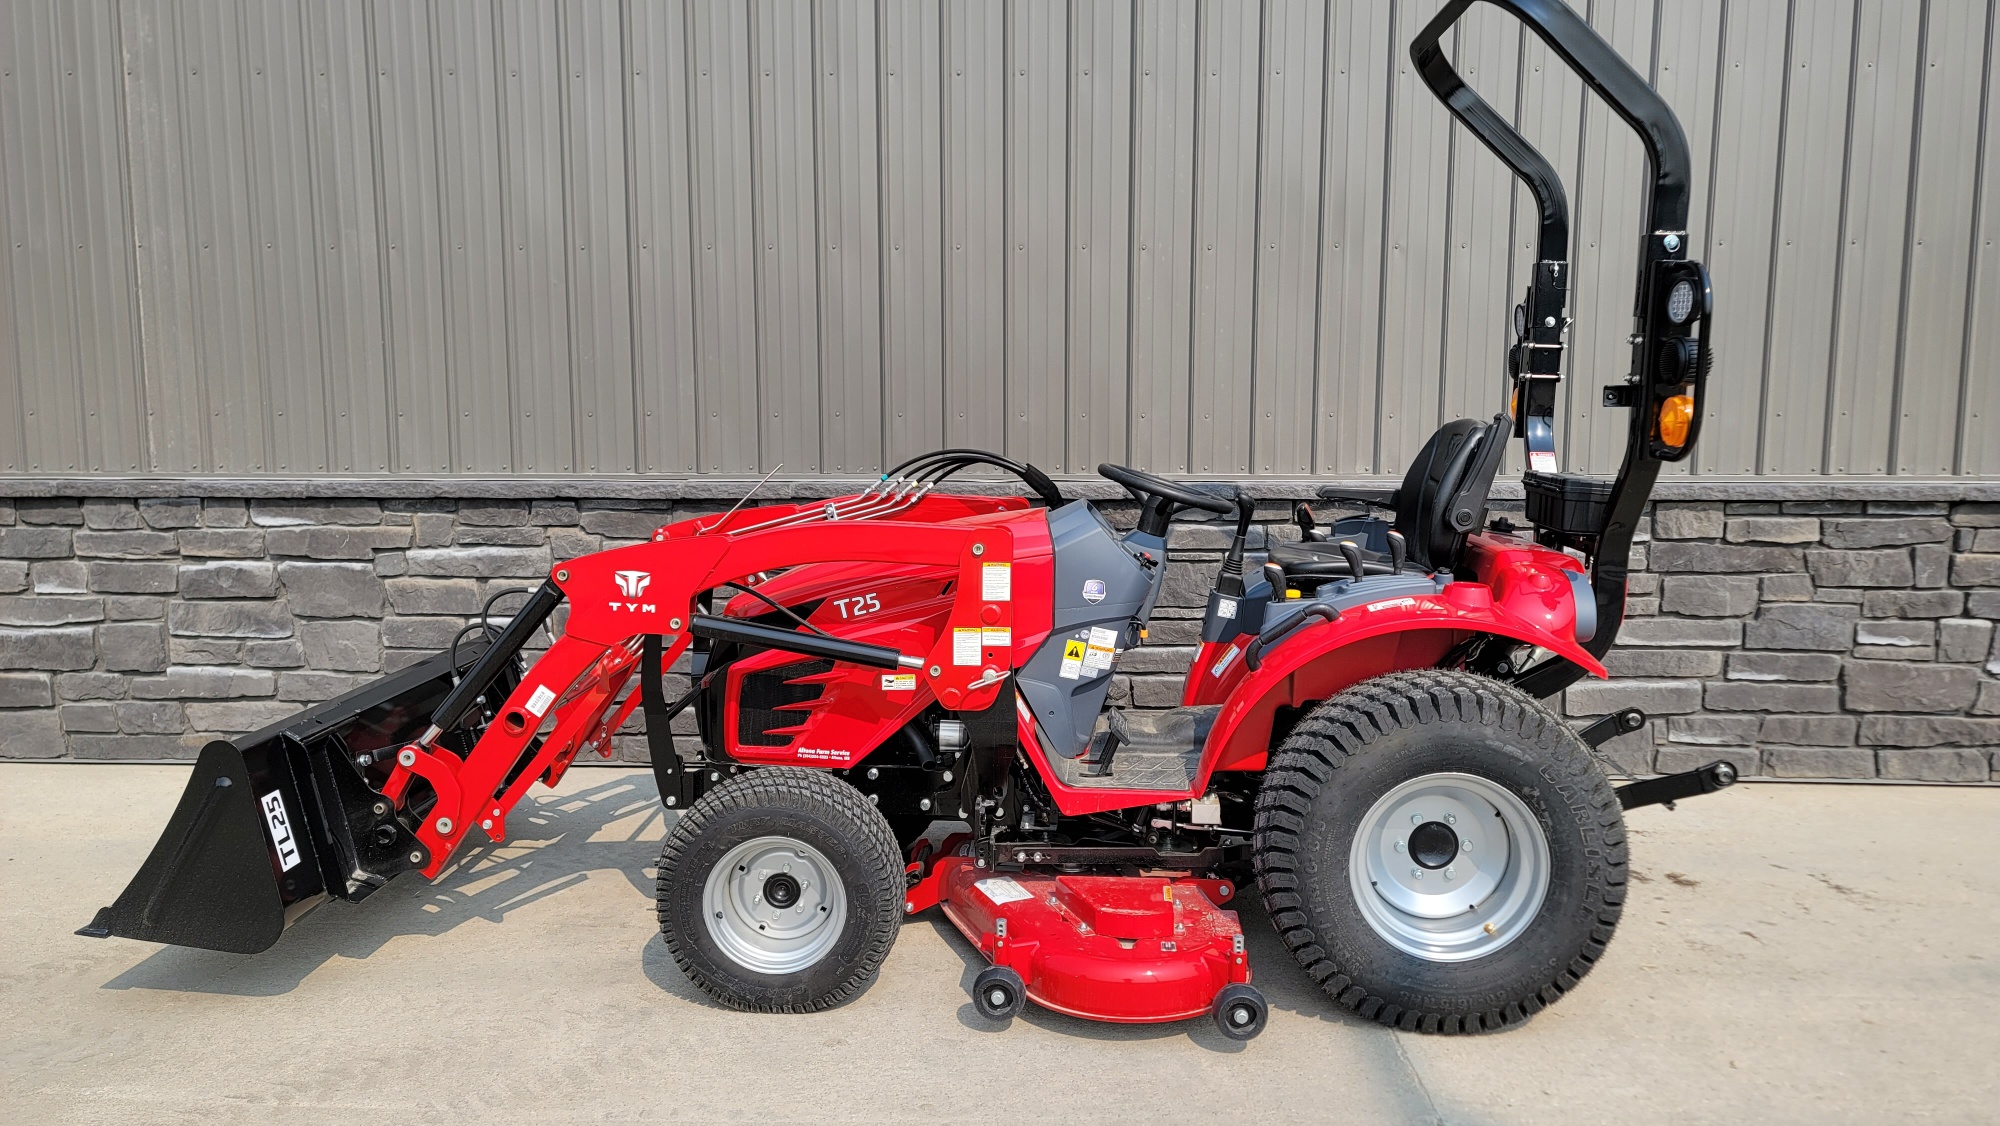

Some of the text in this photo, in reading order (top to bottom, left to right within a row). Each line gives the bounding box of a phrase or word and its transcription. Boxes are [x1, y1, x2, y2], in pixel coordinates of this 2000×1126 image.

[608, 601, 656, 613] TYM
[833, 592, 881, 619] T25
[265, 796, 295, 866] TL25
